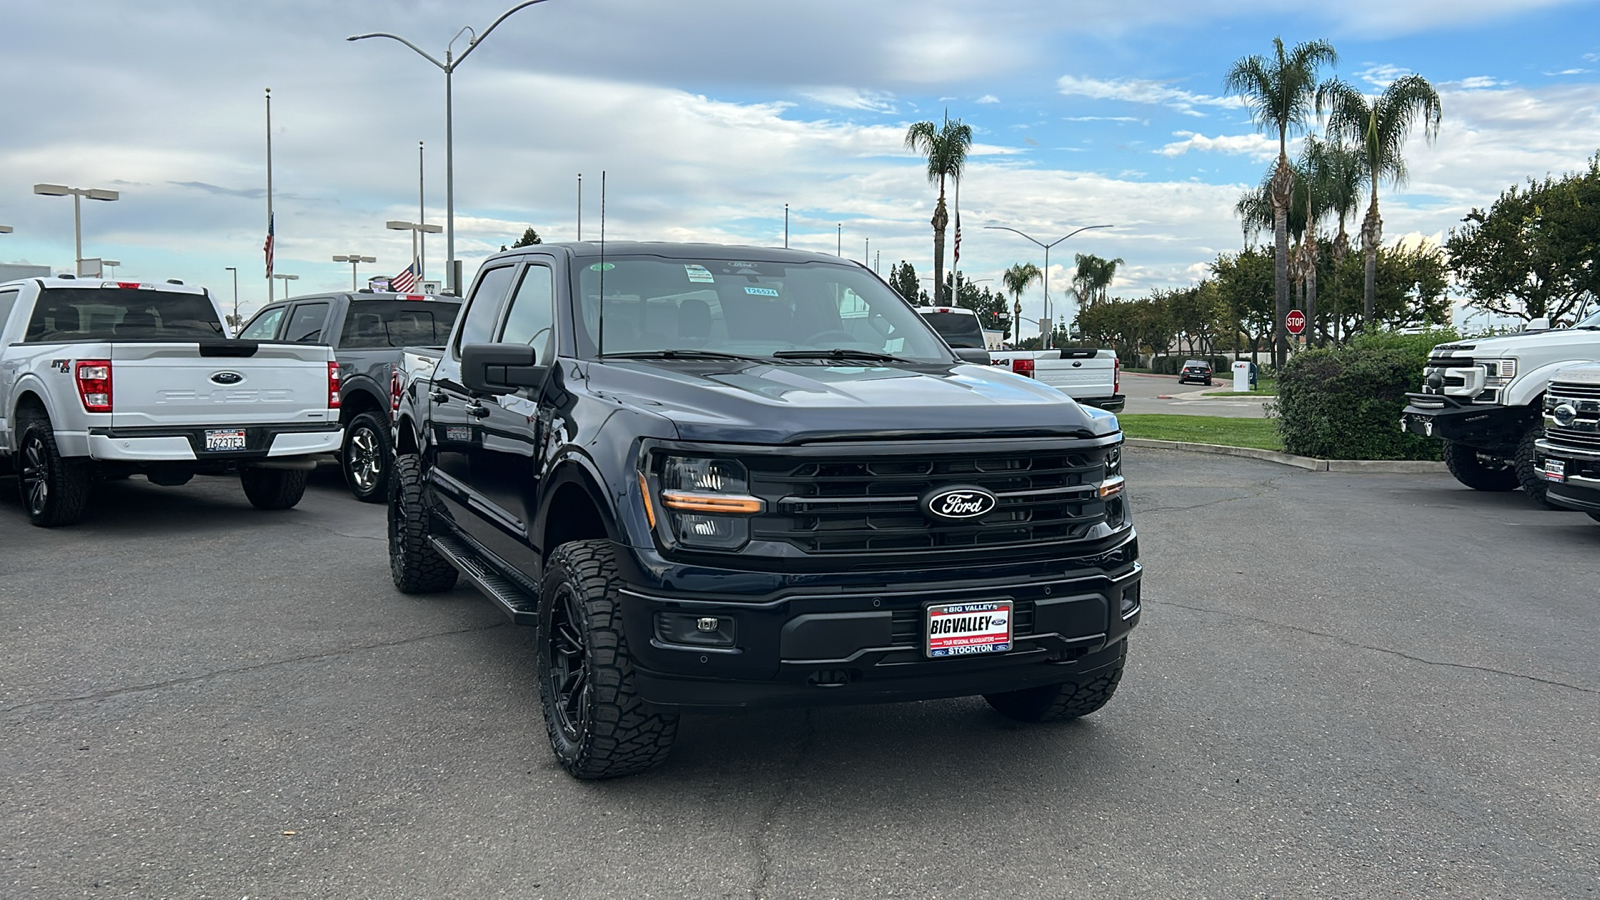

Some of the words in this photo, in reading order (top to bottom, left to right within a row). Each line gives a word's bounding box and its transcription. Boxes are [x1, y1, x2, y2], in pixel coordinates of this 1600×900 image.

[1287, 317, 1304, 327] STOP
[155, 389, 294, 403] F-150
[207, 437, 244, 448] 76237E3
[942, 494, 983, 514] Ford
[948, 605, 963, 613] BIG
[964, 603, 993, 612] VALLEY
[930, 615, 993, 635] BIGVALLEY
[948, 644, 993, 655] STOCKTON
